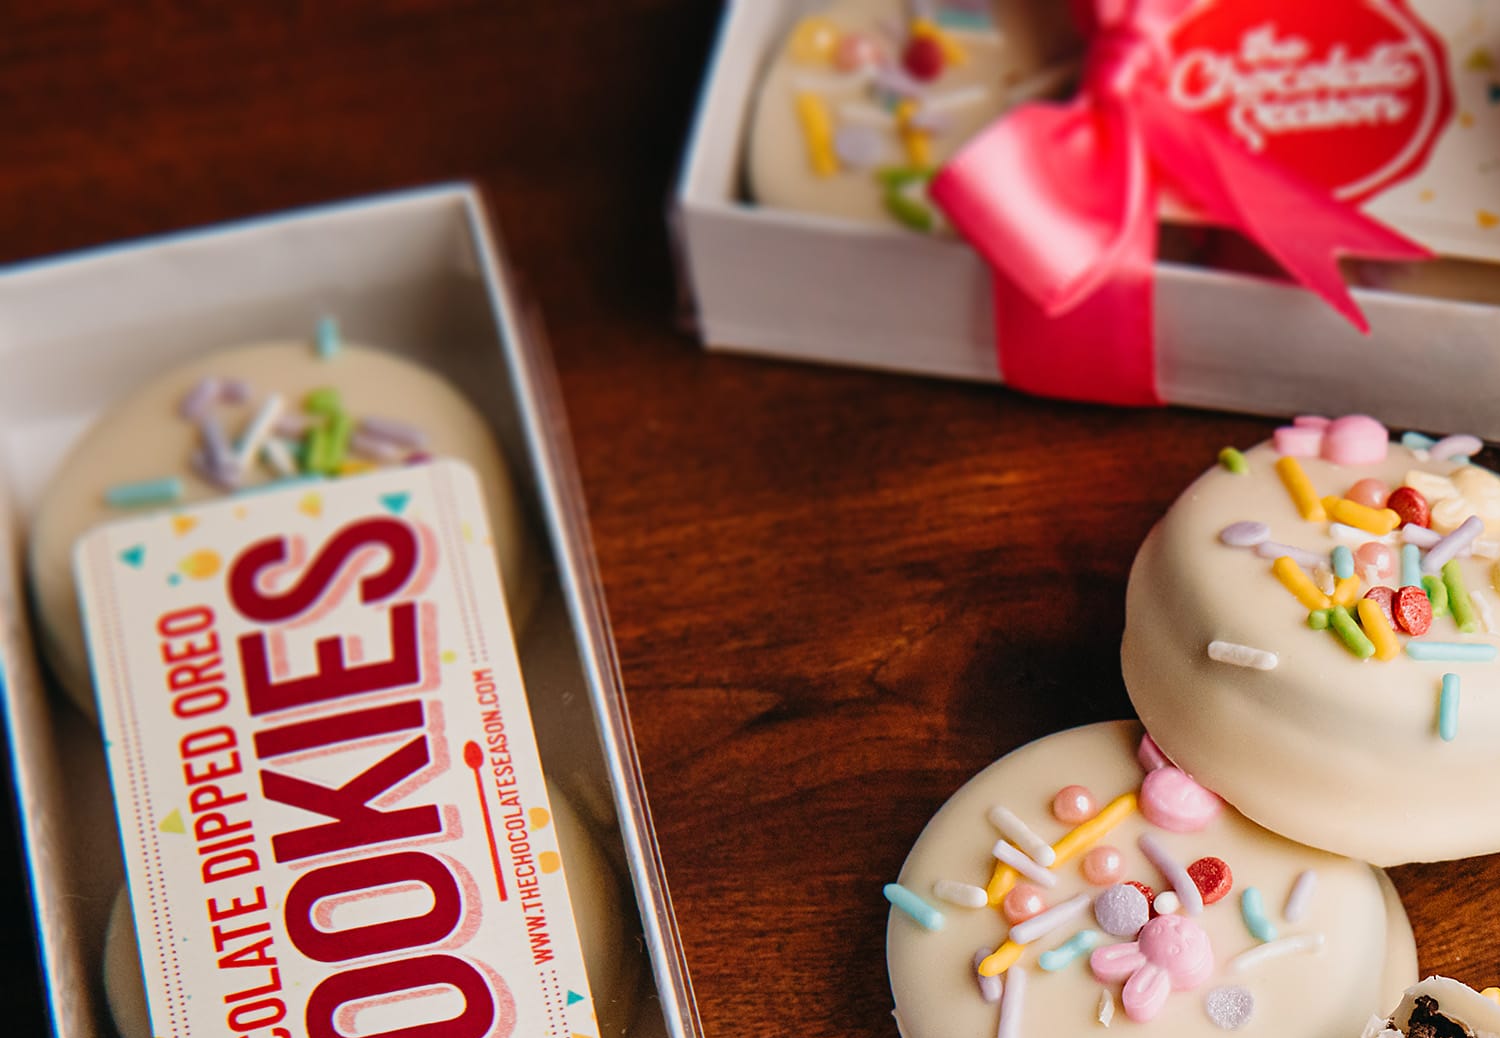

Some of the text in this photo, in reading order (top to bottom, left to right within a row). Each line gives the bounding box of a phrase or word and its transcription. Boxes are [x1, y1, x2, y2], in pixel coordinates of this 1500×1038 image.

[156, 604, 231, 720] OREO
[180, 724, 260, 884] DIPPED
[472, 667, 555, 965] WWW.THECHOCOLATESEASON.COM
